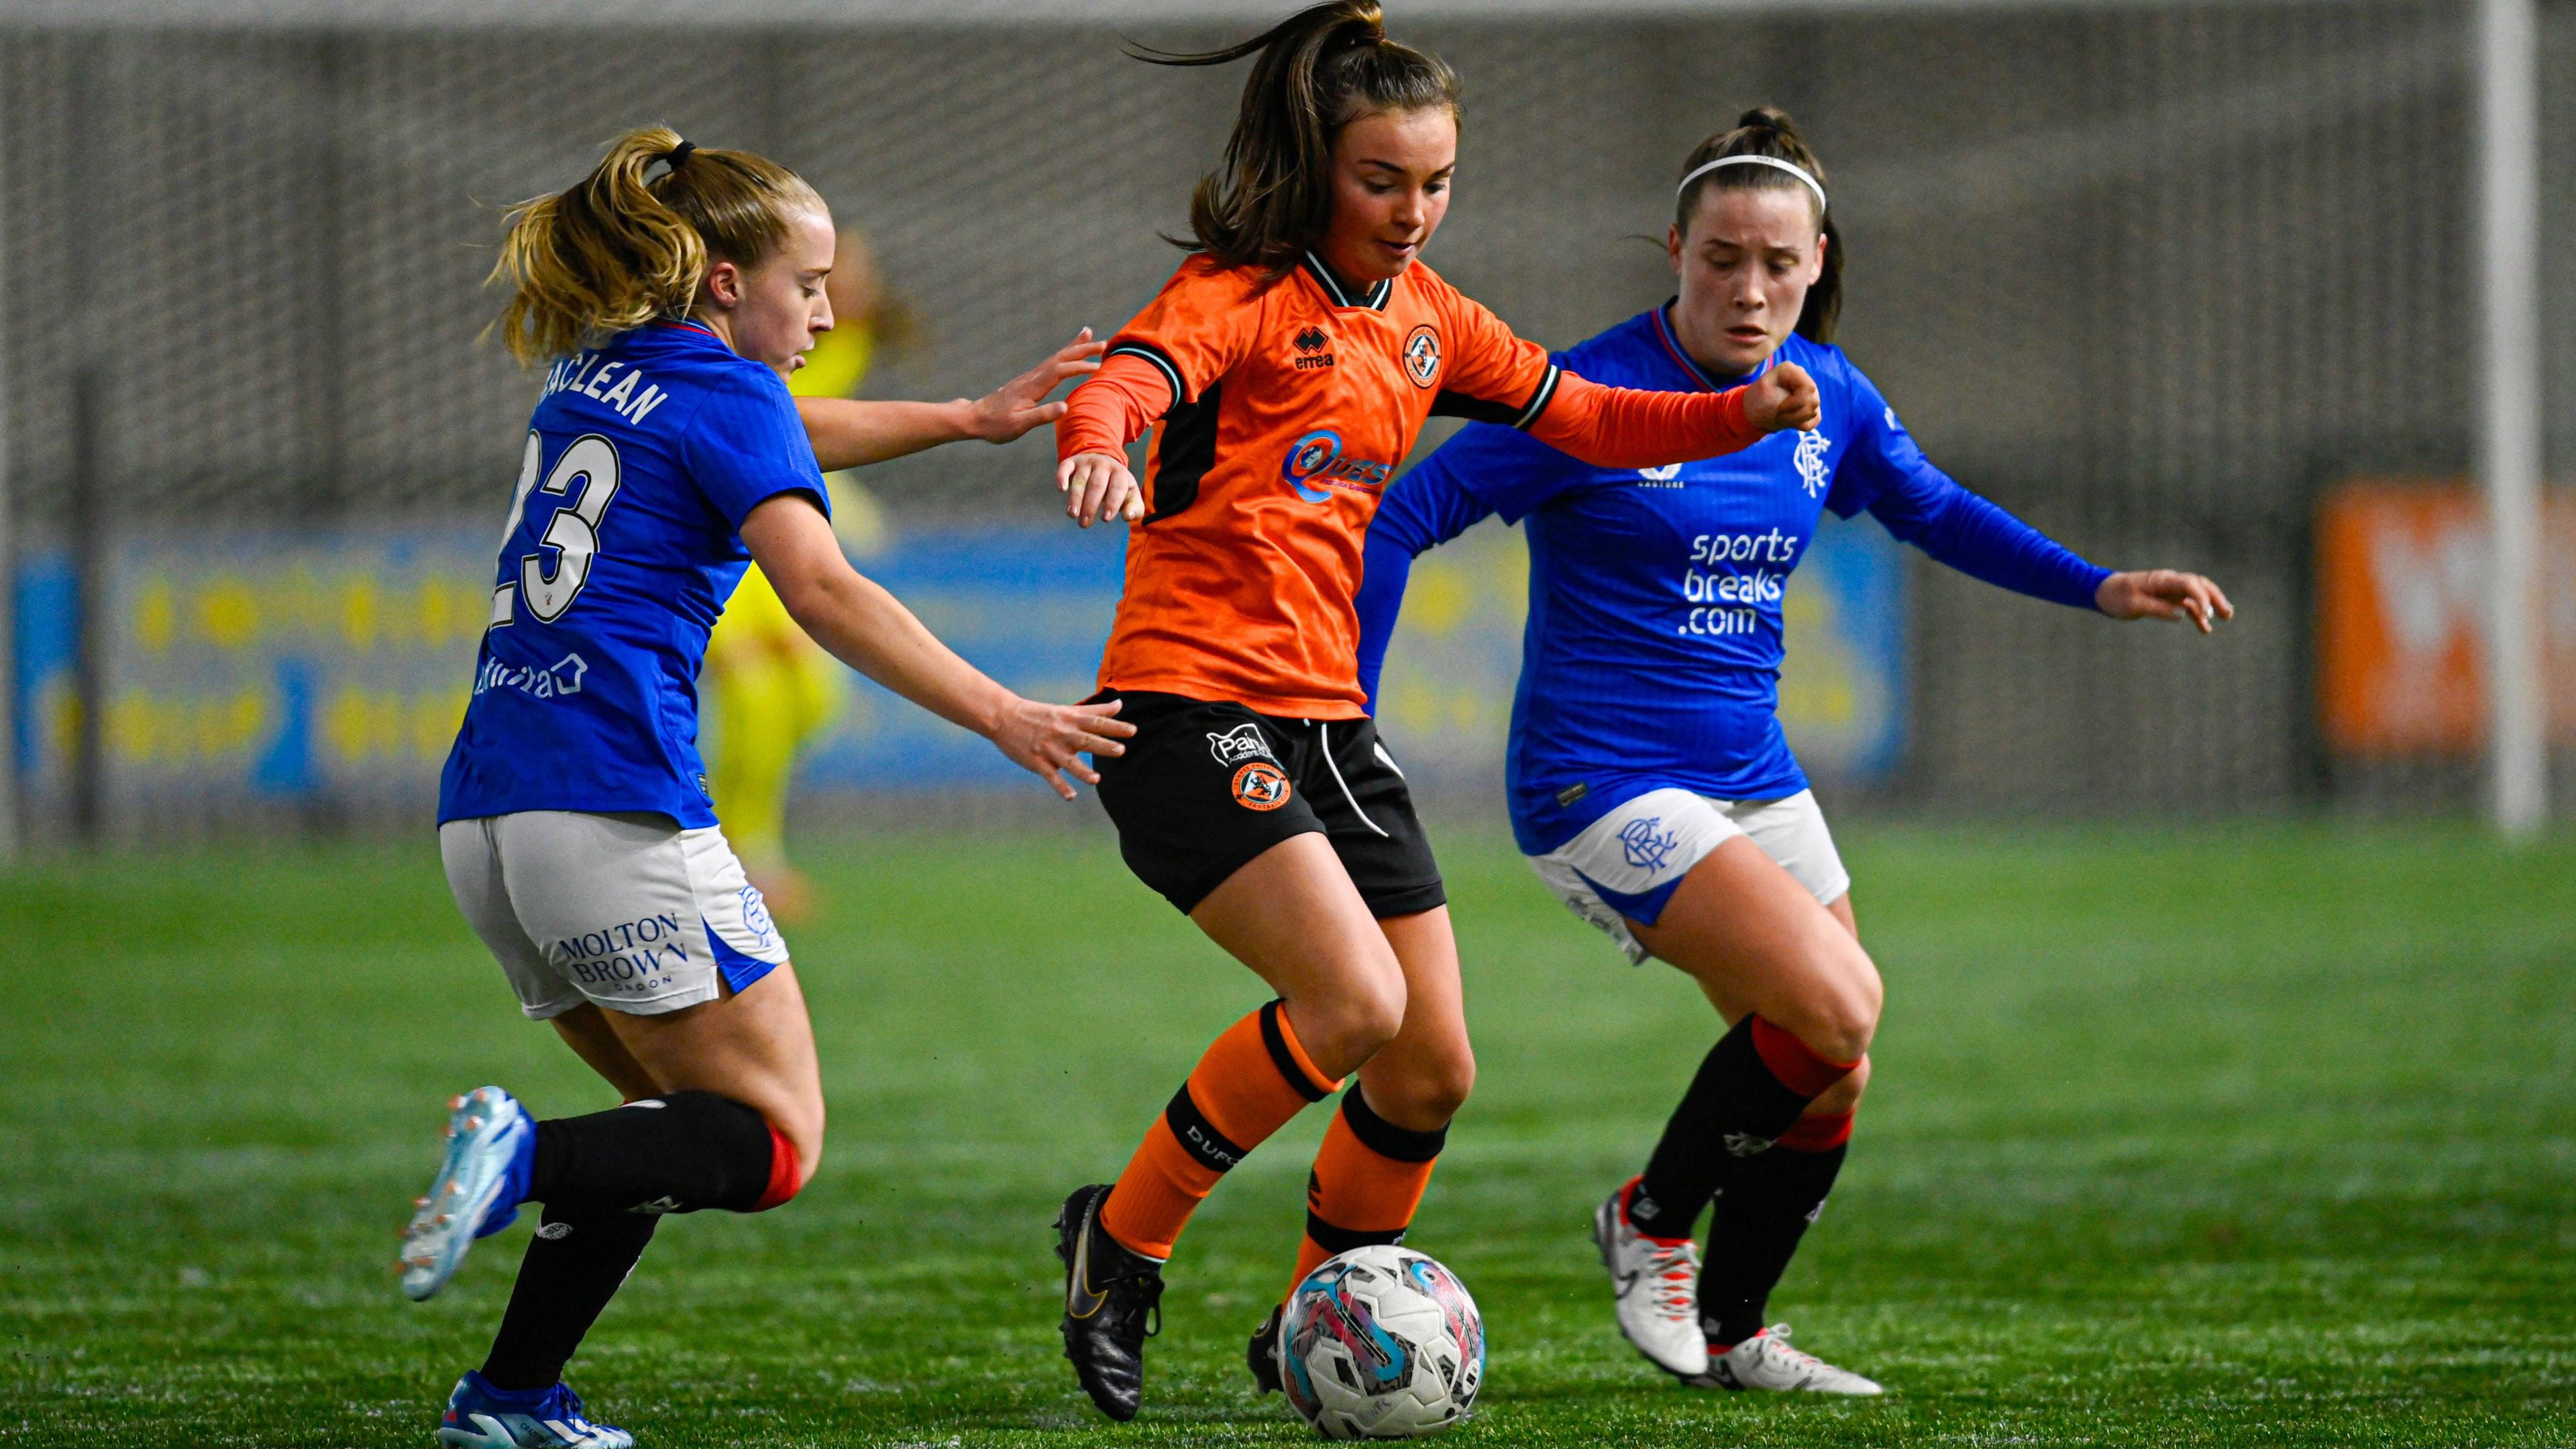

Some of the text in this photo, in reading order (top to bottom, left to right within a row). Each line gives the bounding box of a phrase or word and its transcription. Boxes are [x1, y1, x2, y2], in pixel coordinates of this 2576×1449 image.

[1295, 353, 1334, 370] errea
[539, 353, 669, 425] ACLEAN
[1281, 429, 1395, 503] QUES
[490, 429, 621, 629] 23
[1690, 527, 1798, 566] sports
[1683, 568, 1783, 603] breaks
[1678, 606, 1756, 635] .com
[559, 912, 680, 959] MOLTON
[573, 943, 688, 983] BROWN
